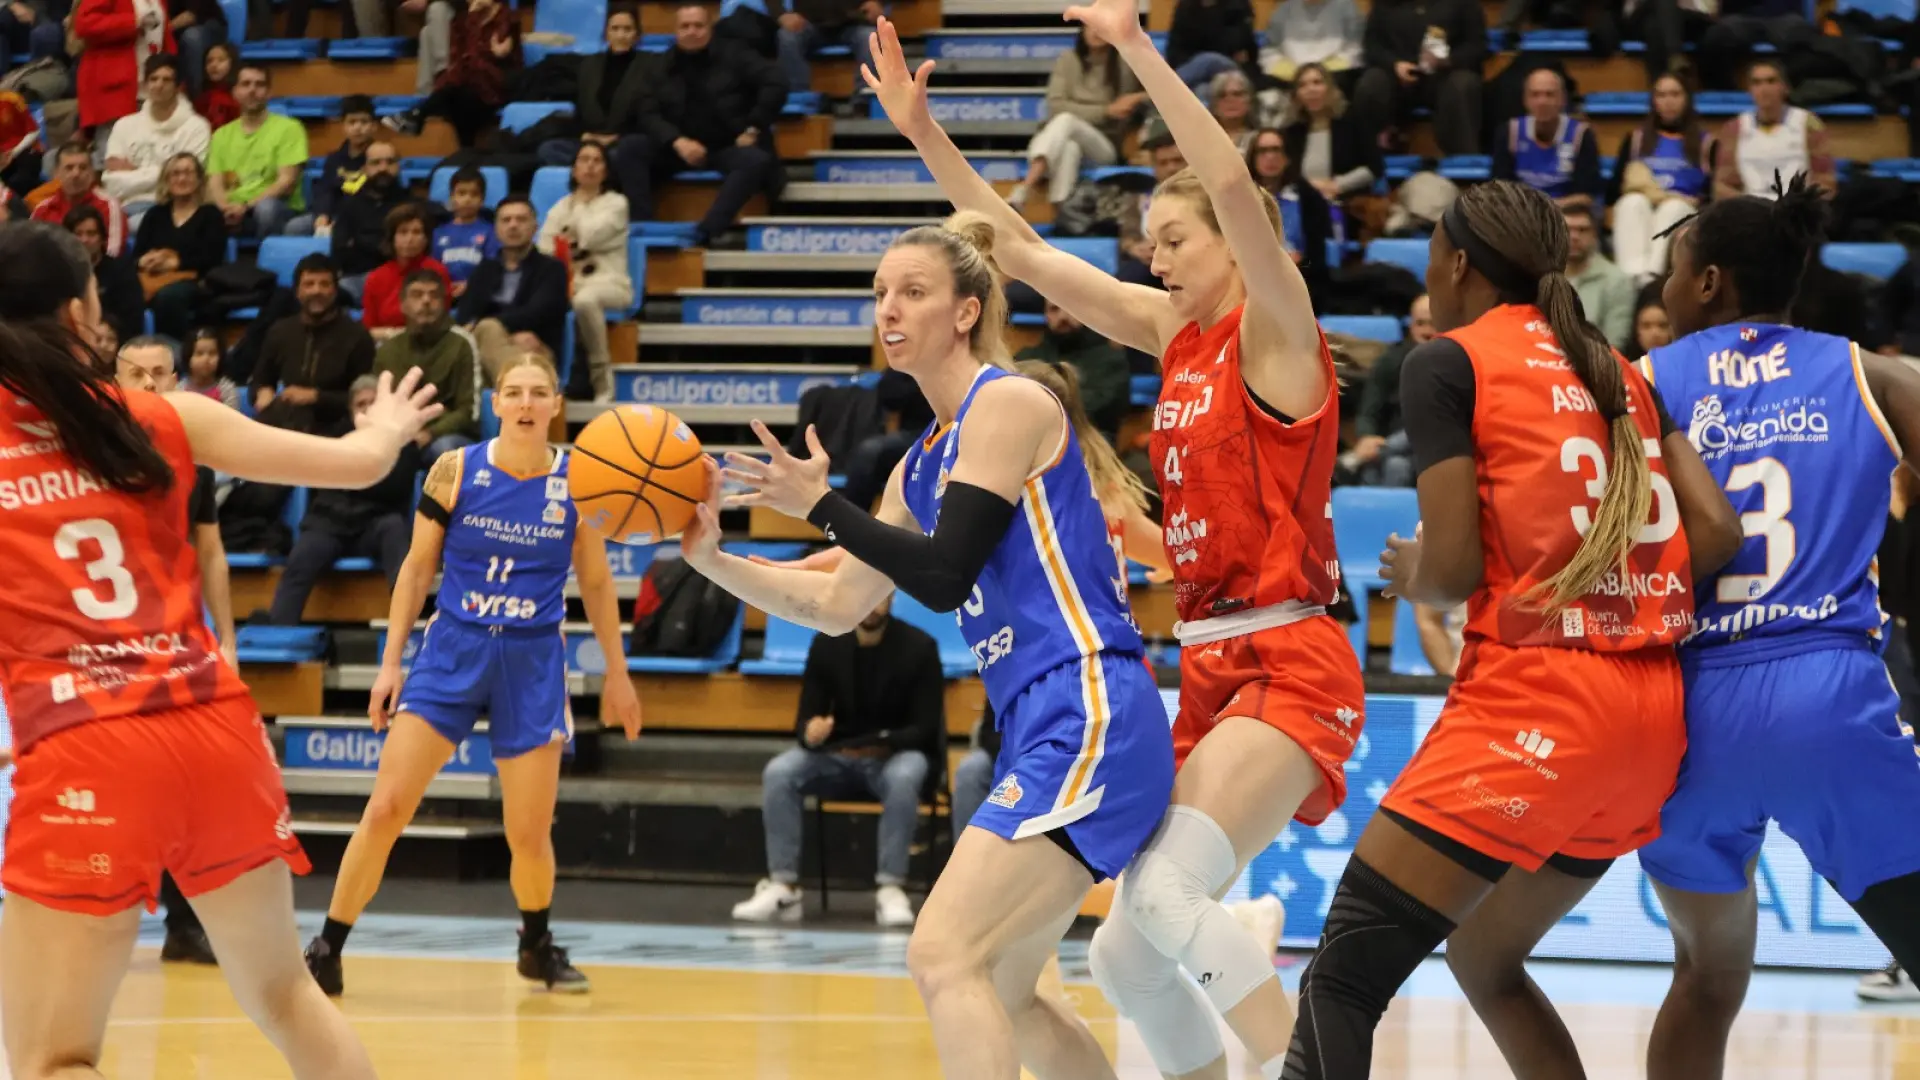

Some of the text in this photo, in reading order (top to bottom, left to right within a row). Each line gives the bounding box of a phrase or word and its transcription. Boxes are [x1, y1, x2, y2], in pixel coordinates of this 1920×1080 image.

[632, 376, 780, 404] Galiproject
[0, 467, 110, 510] SORIA
[462, 514, 522, 534] CASTILLA
[523, 524, 533, 537] Y
[1716, 456, 1796, 603] 3
[54, 518, 138, 620] 3
[486, 555, 515, 584] 11
[1587, 624, 1601, 635] DE
[1652, 608, 1694, 635] gali
